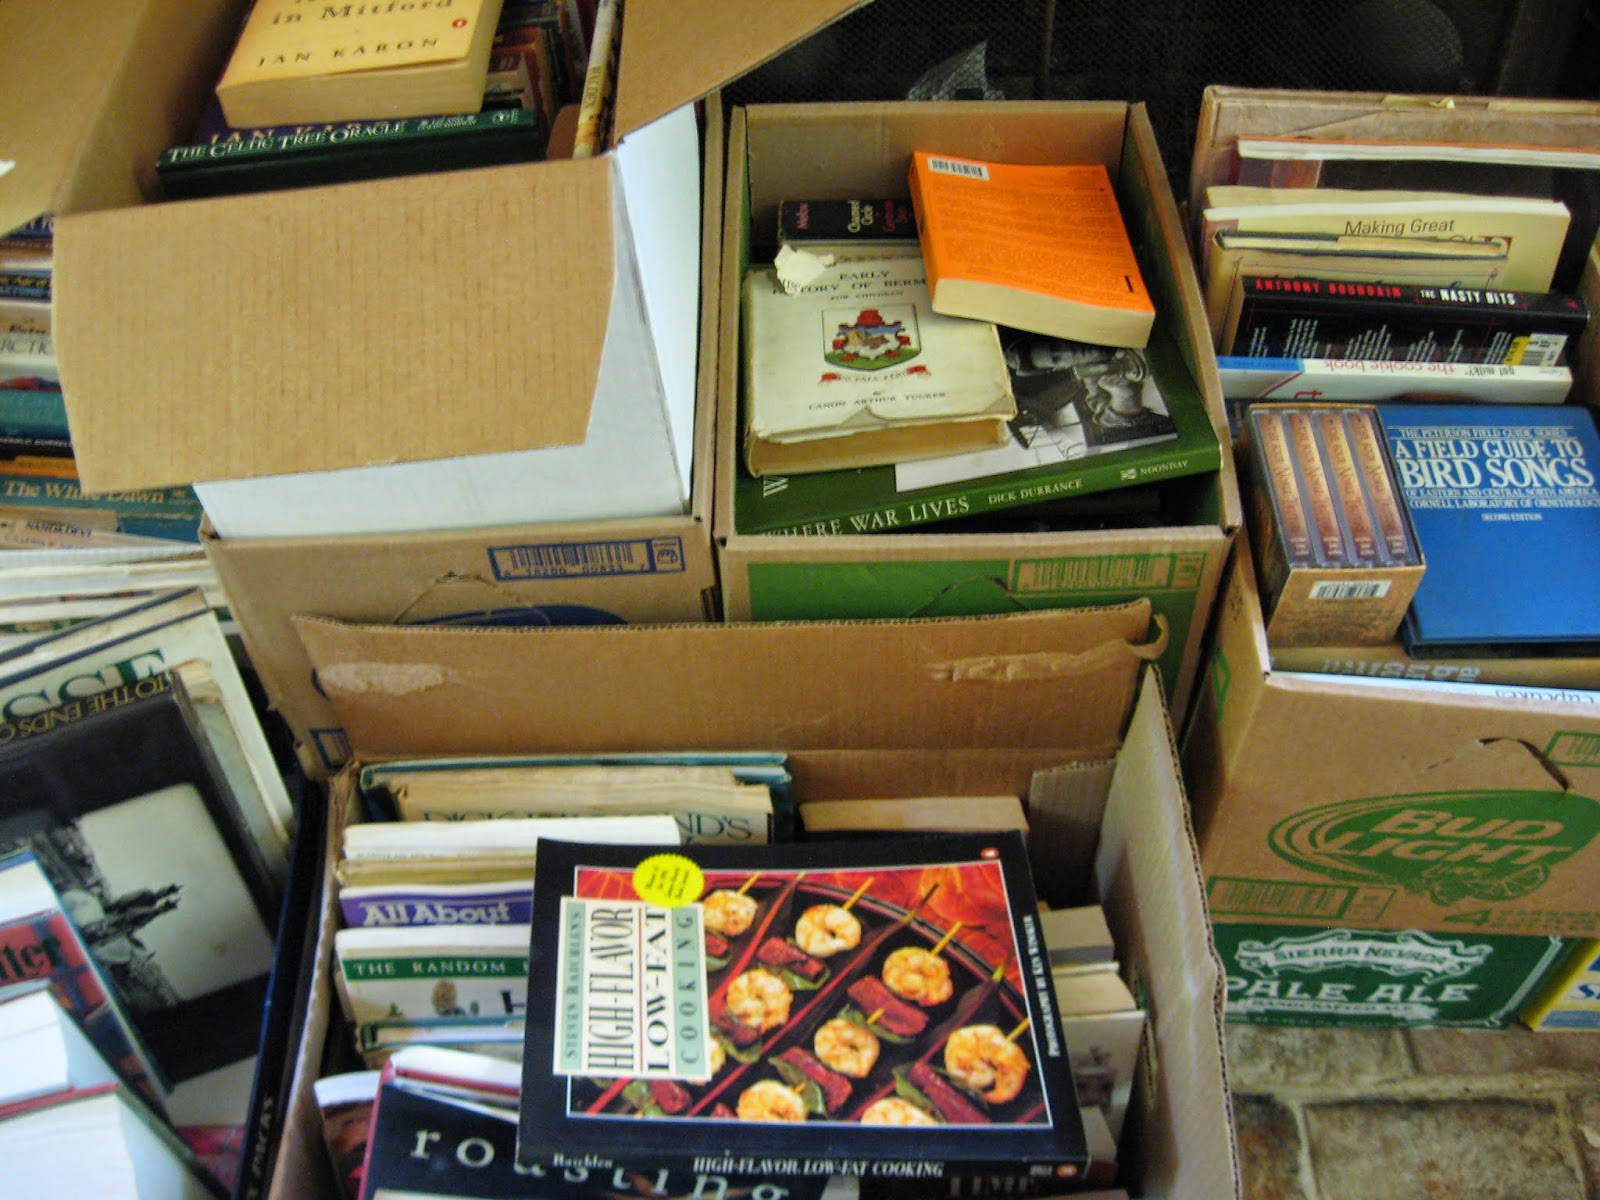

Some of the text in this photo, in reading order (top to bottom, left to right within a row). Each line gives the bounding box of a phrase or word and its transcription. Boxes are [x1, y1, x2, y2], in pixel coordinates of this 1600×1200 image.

[321, 0, 452, 20] Mitford
[258, 38, 438, 67] JAN KARON
[168, 146, 207, 163] THE
[210, 137, 275, 158] CELTIC
[278, 130, 328, 150] TREE
[329, 119, 408, 143] ORACLE
[1344, 218, 1456, 237] Making Great
[840, 271, 890, 280] EARLY
[1255, 279, 1517, 306] ANTHONY BOURDAIN THE NASTY BITS
[1324, 358, 1456, 376] the cookie book
[808, 391, 946, 411] CANON ARTHUR TUCKER
[1400, 428, 1420, 438] THE
[1421, 428, 1470, 438] PETERSON
[1472, 428, 1499, 438] FIELD
[1503, 428, 1531, 438] GUIDE
[1395, 438, 1584, 459] A FIELD GUIDE TO
[1397, 457, 1596, 489] BIRD SONGS
[3, 480, 42, 498] The
[850, 509, 900, 533] WAR
[908, 497, 970, 523] LIVES
[988, 490, 1017, 505] DICK
[1020, 478, 1083, 499] DURRANCE
[1140, 460, 1189, 476] NOONDAY
[1406, 488, 1417, 498] OF
[1464, 488, 1482, 498] AND
[1483, 488, 1524, 498] CENTRAL
[1409, 500, 1454, 509] CORNELL
[1455, 500, 1519, 509] LABORATORY
[1520, 500, 1532, 509] OF
[1481, 512, 1543, 522] SECOND EDITION
[88, 686, 135, 712] THE
[135, 674, 170, 699] TO
[19, 702, 83, 738] ENDS
[1322, 831, 1573, 865] LIGHT
[361, 902, 512, 927] All About
[353, 959, 506, 976] THE RANDOM
[587, 907, 634, 1070] HIGH-FLAVOR
[646, 905, 670, 1071] LOW-FAT
[676, 914, 700, 1064] COOKING
[1226, 975, 1480, 1002] PALE ALE
[565, 1003, 578, 1060] STEVEN
[692, 1155, 798, 1175] HIGH-FLAVOR
[802, 1159, 869, 1176] LOW-FAT
[872, 1160, 945, 1178] COOKING
